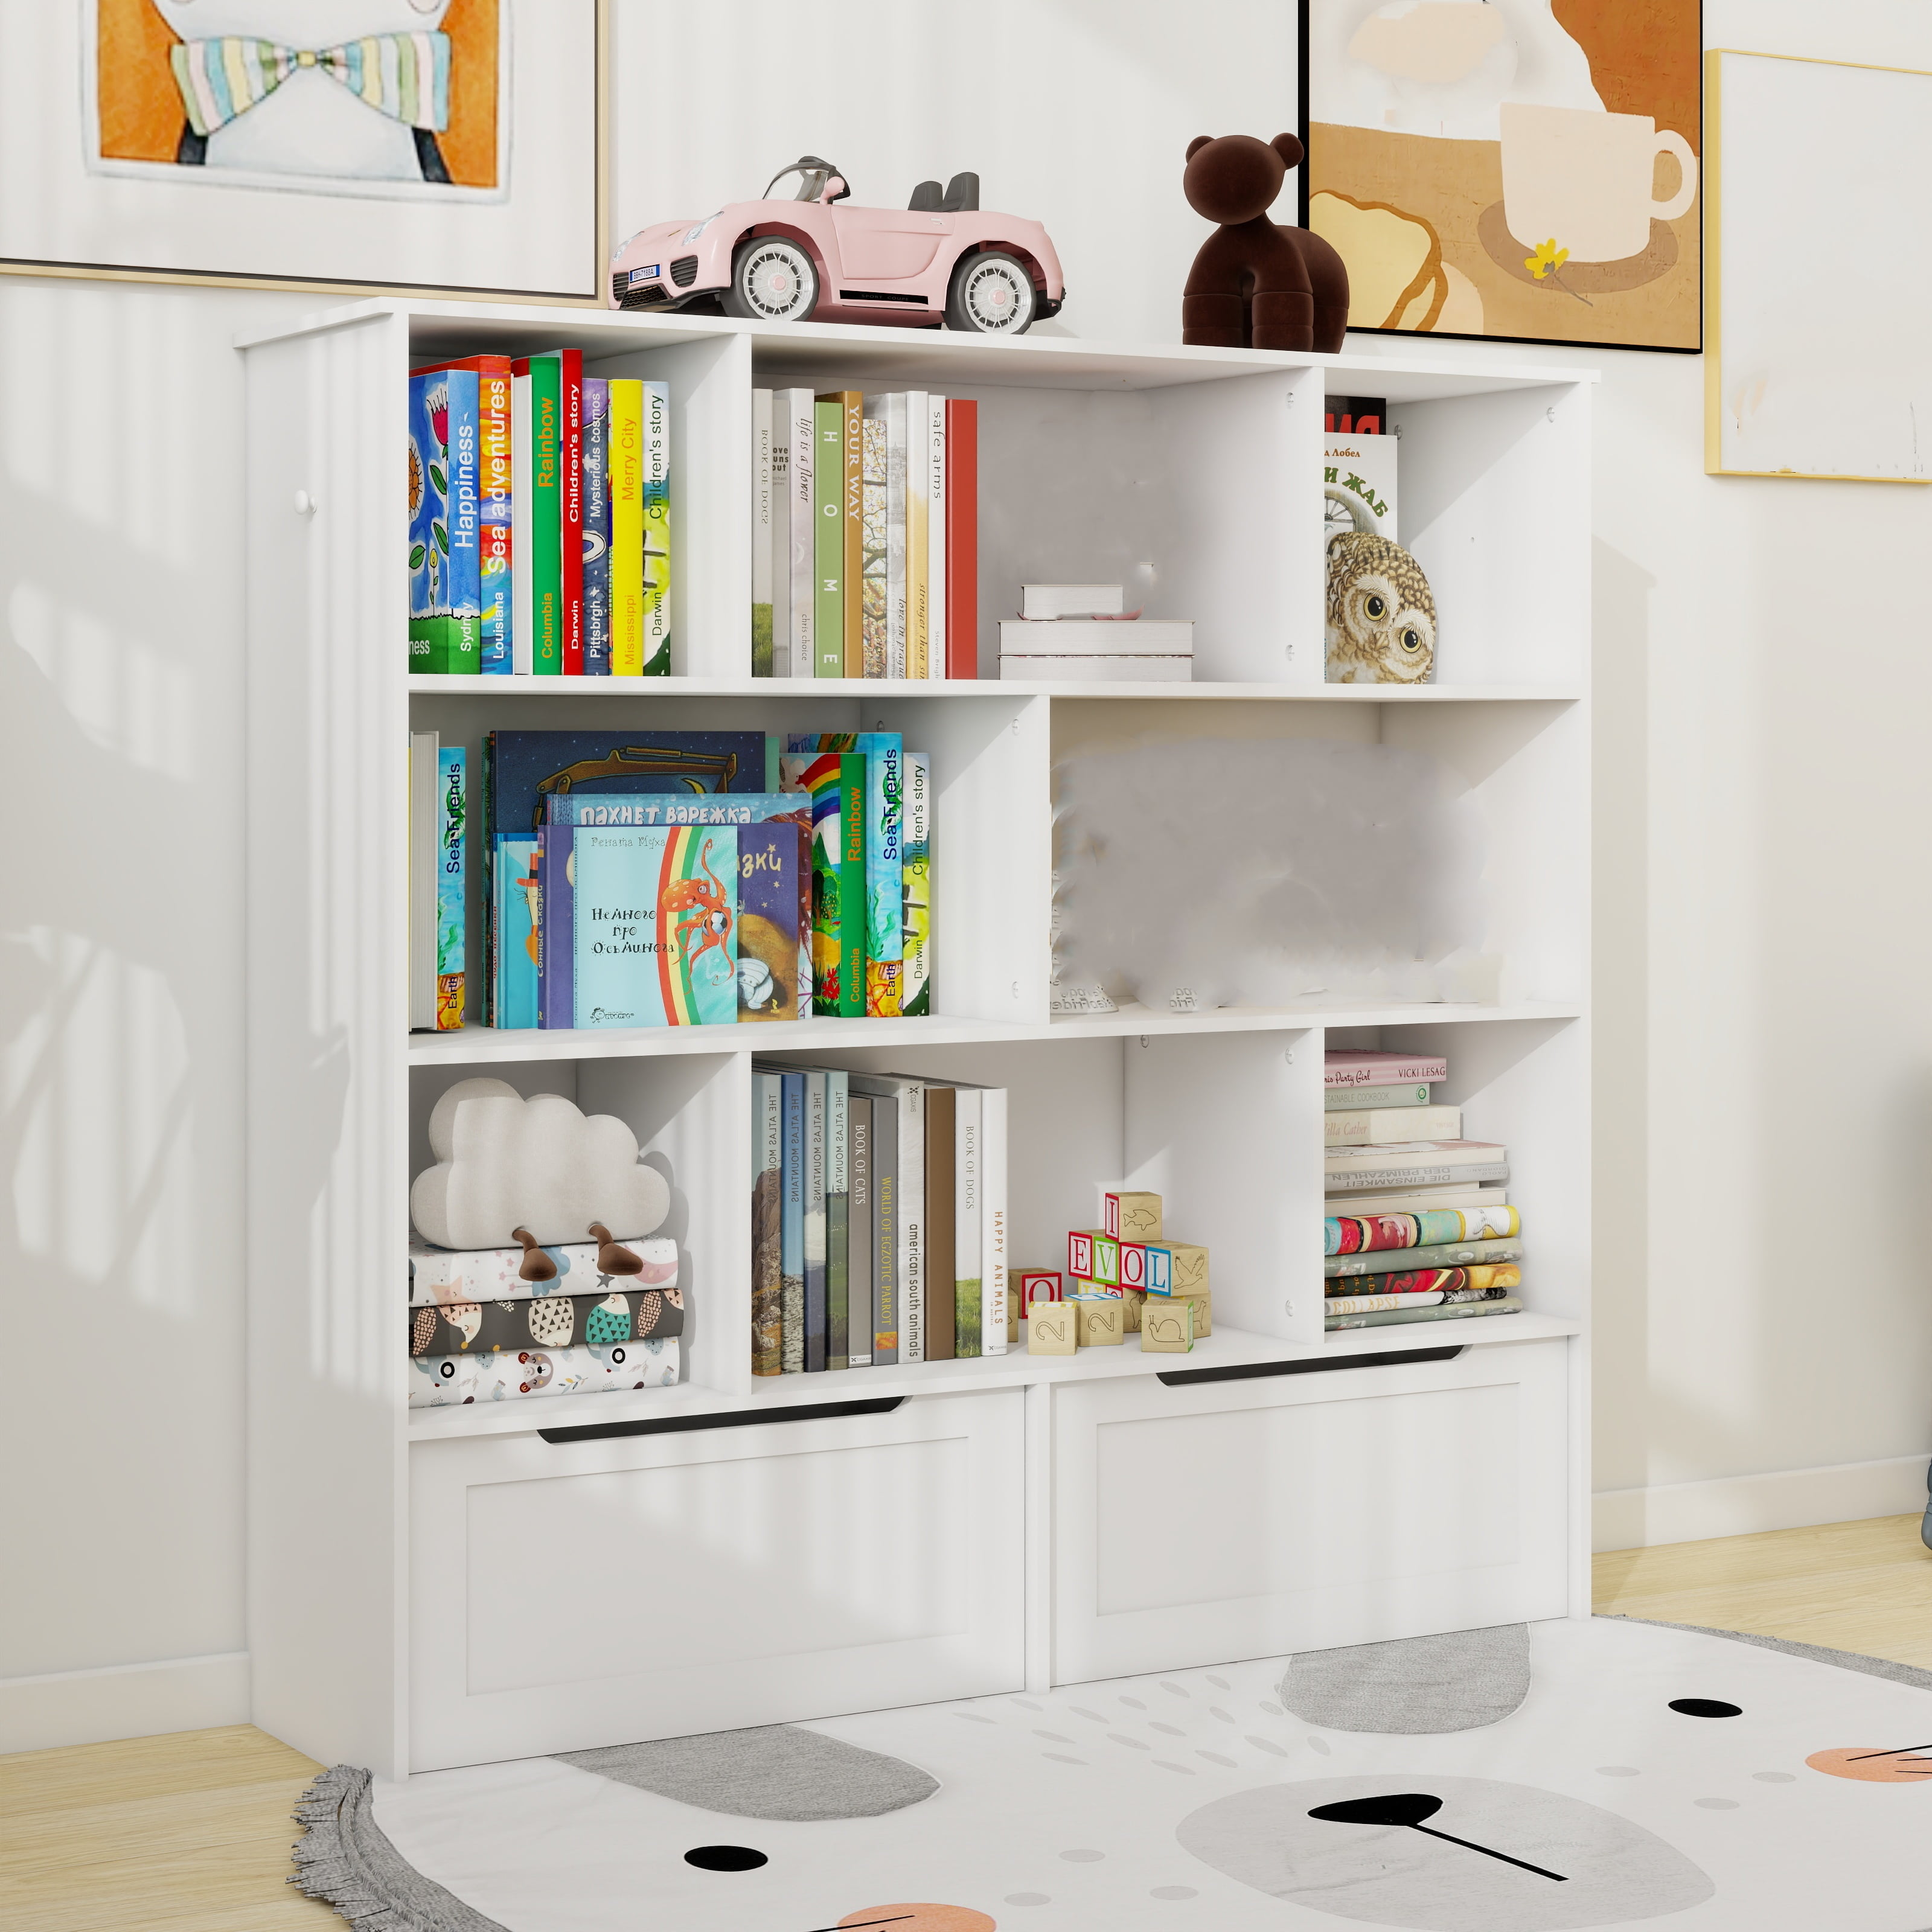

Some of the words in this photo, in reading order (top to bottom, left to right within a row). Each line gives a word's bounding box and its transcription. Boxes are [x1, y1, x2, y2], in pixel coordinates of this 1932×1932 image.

[571, 384, 580, 428] story
[591, 393, 601, 443] cosmos
[651, 395, 664, 434] story
[538, 397, 554, 487] Rainbow
[621, 417, 637, 448] City
[796, 418, 813, 437] life
[800, 441, 811, 451] is
[849, 405, 859, 466] YOUR
[933, 412, 945, 447] safe
[488, 381, 505, 518] adventures
[800, 455, 808, 464] a
[1332, 447, 1361, 458] Лобел
[455, 425, 473, 548] Happiness
[570, 430, 578, 523] Children's
[589, 447, 601, 517] Mysterious
[622, 455, 637, 501] Merry
[649, 440, 662, 519] Children's
[796, 464, 813, 503] flower
[1342, 472, 1389, 517] ЖАБ
[849, 475, 859, 521] WAY
[488, 530, 506, 574] Sea
[493, 592, 504, 659] Louisiana
[542, 592, 553, 659] Columbia
[571, 600, 579, 650] Darwin
[653, 592, 662, 636] Darwin
[916, 583, 926, 631] stronger
[461, 602, 474, 652] Sydny
[590, 600, 602, 658] Pittsbrgh
[624, 594, 635, 665] Mississippi
[898, 624, 906, 637] in
[920, 635, 928, 661] than
[447, 763, 461, 831] Friends
[883, 749, 897, 817] Friends
[913, 765, 926, 800] story
[580, 806, 661, 825] ПАХНЕТ
[665, 806, 752, 824] ВАРЕЖКА
[848, 787, 861, 862] Rainbow
[446, 838, 460, 874] Sea
[591, 837, 633, 847] Рената
[638, 836, 666, 849] Муха
[883, 825, 897, 860] Sea
[912, 805, 923, 875] Children's
[592, 908, 657, 921] Немного
[612, 925, 638, 940] про
[592, 941, 675, 954] Осьминога
[914, 940, 923, 979] Darwin
[448, 976, 457, 1009] Earth
[850, 948, 860, 1002] Columbia
[886, 964, 896, 997] Earth
[1335, 1072, 1354, 1086] Party
[1356, 1070, 1371, 1083] Girl
[1398, 1067, 1419, 1078] VICKI
[1357, 1092, 1390, 1102] COOKBOOK
[855, 1124, 865, 1156] BOOK
[965, 1125, 974, 1156] BOOK
[1343, 1121, 1367, 1136] Cather
[855, 1159, 866, 1174] OF
[965, 1160, 974, 1175] OF
[1332, 1168, 1419, 1181] PRIMZAHLEN
[1344, 1176, 1425, 1188] EINSAMKEIT
[855, 1177, 866, 1205] CATS
[881, 1177, 892, 1215] WORLD
[965, 1180, 974, 1209] DOGS
[881, 1219, 892, 1233] OF
[994, 1211, 1003, 1254] HAPPY
[881, 1236, 892, 1282] EGZOTIC
[909, 1223, 918, 1276] american
[881, 1285, 892, 1325] PARROT
[909, 1279, 918, 1311] south
[994, 1264, 1003, 1325] ANIMALS
[909, 1314, 918, 1357] animals
